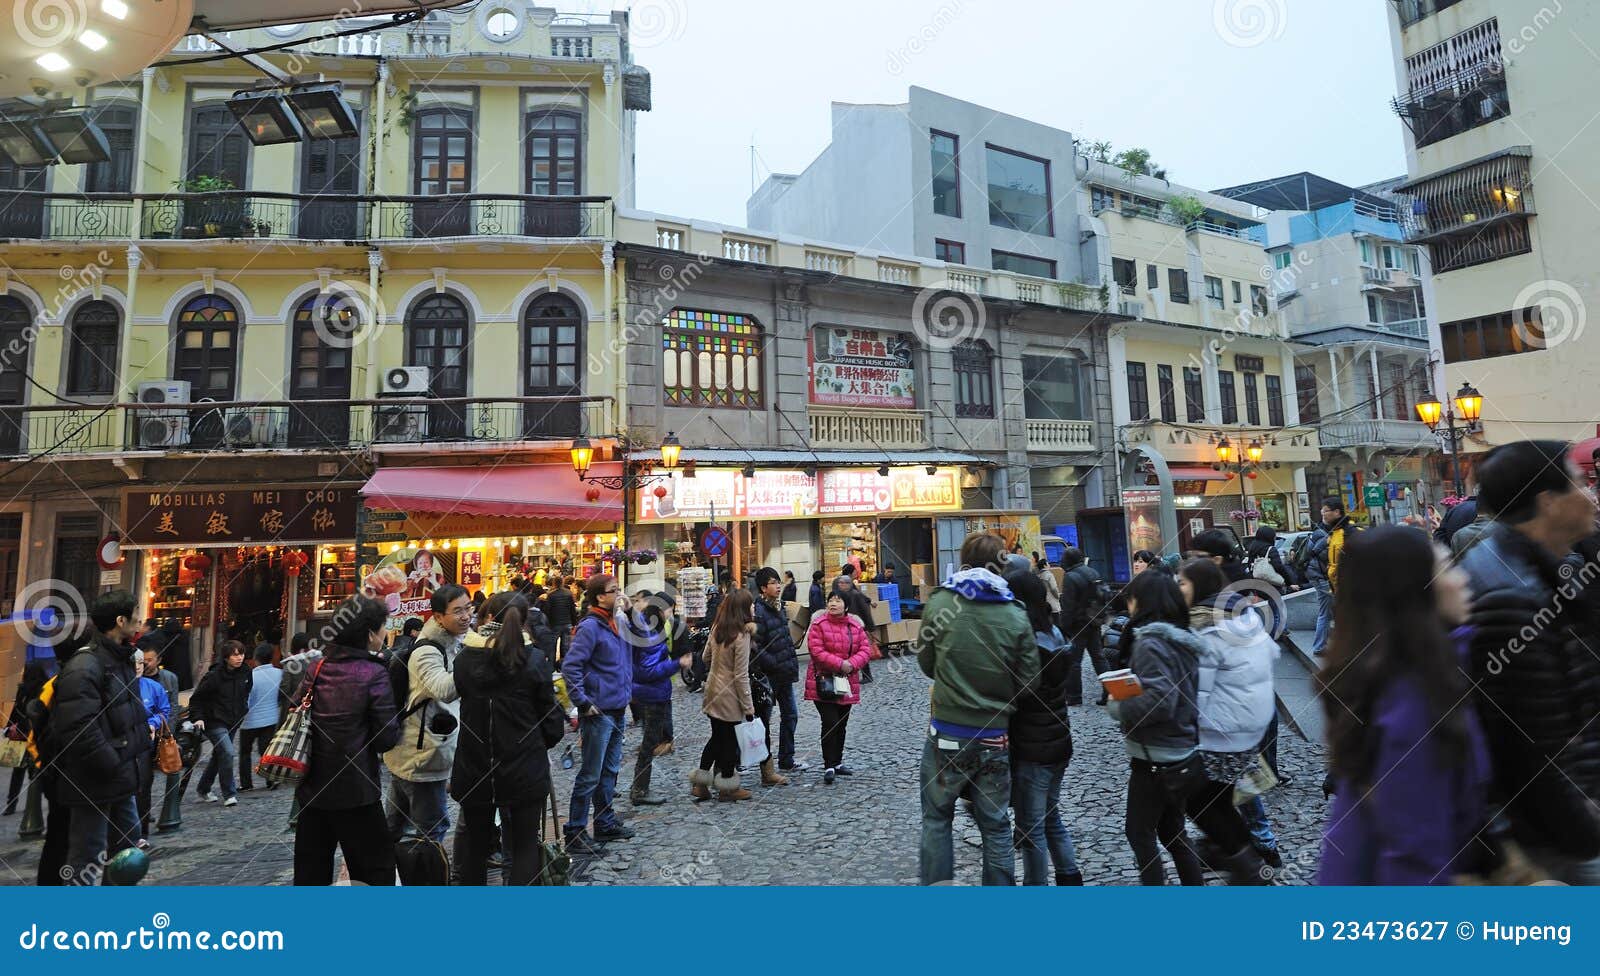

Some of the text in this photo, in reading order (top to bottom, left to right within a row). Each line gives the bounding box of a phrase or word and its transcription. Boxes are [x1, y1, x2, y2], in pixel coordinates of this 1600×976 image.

[834, 356, 865, 366] JAPANESE
[149, 490, 342, 507] MOBILIAS MEI CHOI
